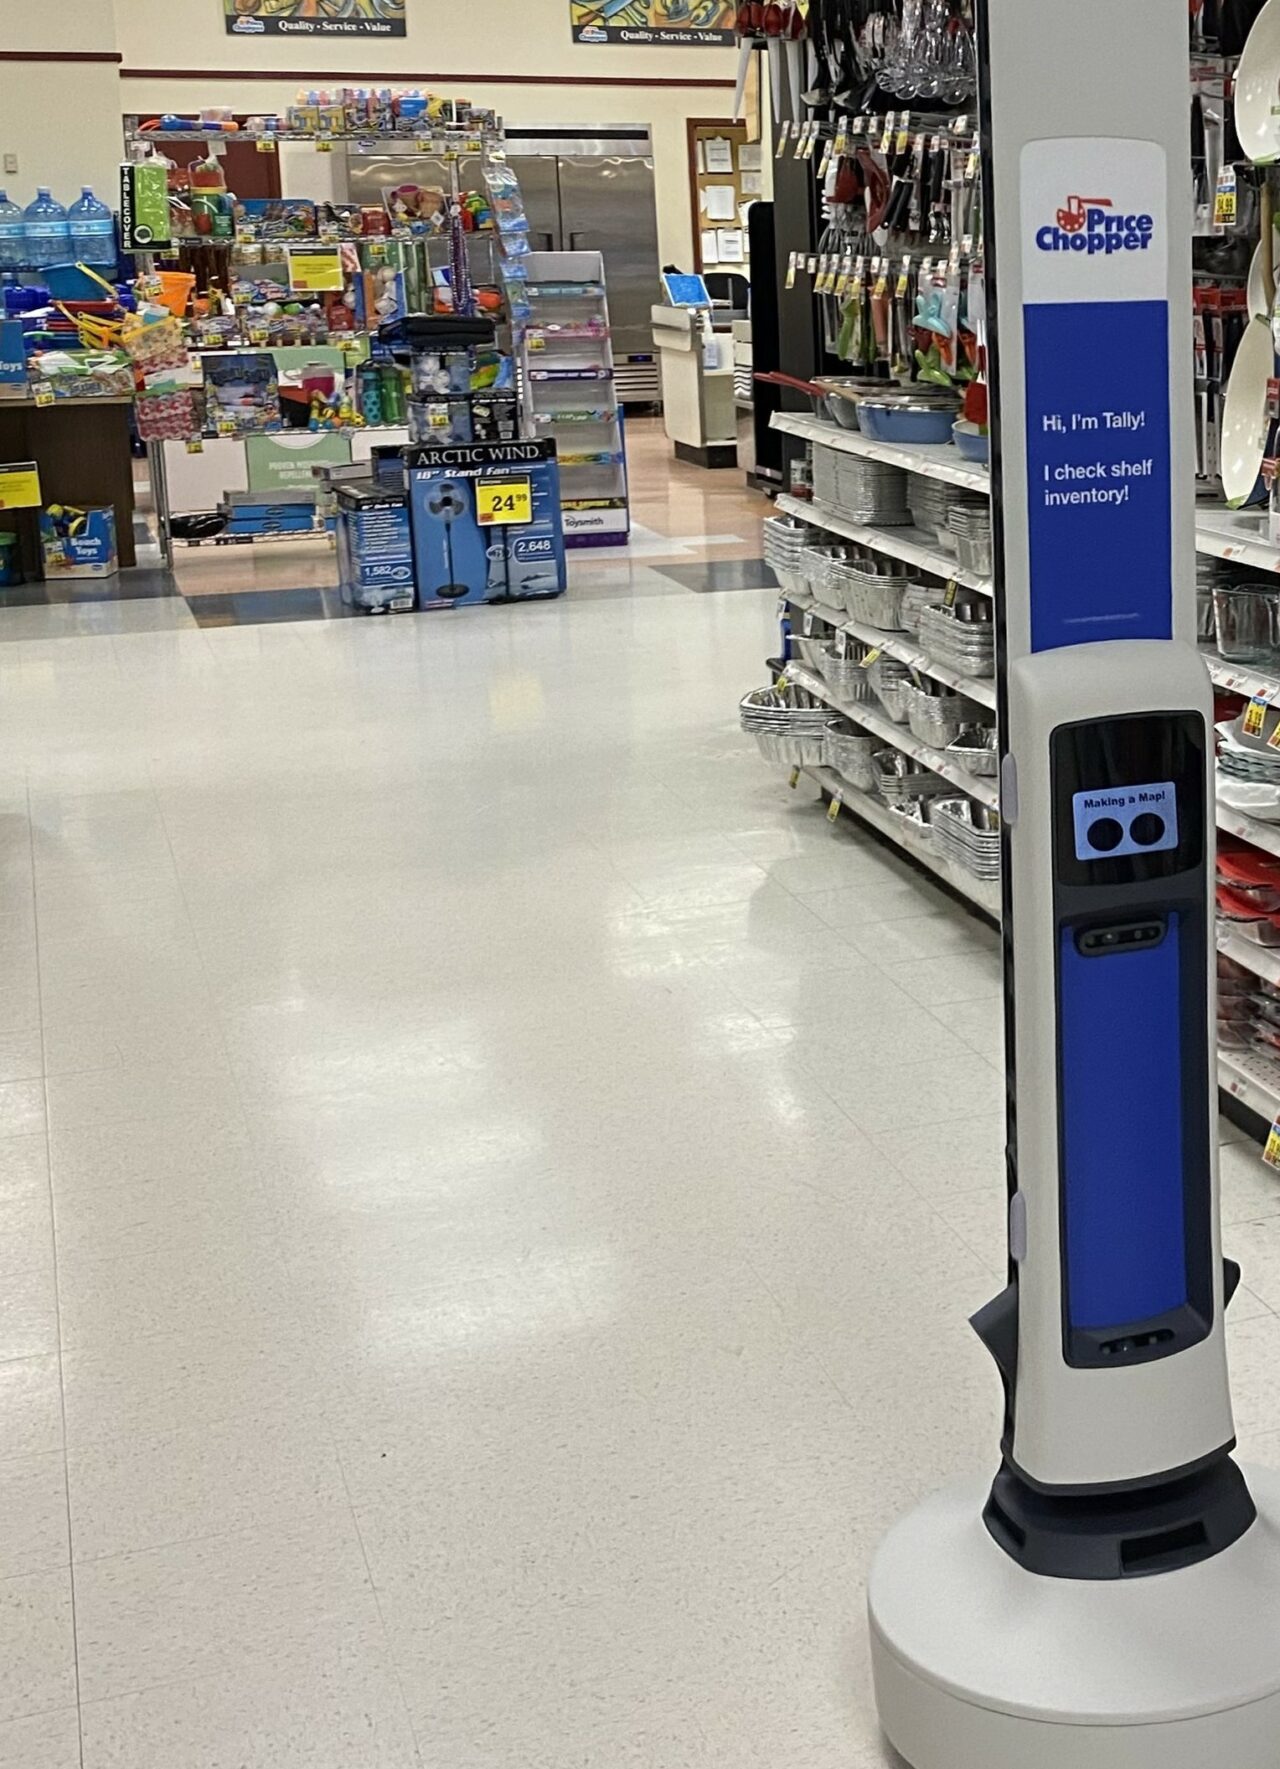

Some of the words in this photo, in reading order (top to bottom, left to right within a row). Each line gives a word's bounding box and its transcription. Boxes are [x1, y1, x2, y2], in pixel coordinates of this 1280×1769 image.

[278, 21, 315, 32] Quality
[322, 22, 357, 31] Service
[364, 22, 391, 32] Value
[620, 30, 653, 41] Quality
[660, 31, 692, 41] Service
[699, 32, 722, 41] Value
[1087, 208, 1153, 233] Price
[1036, 225, 1153, 254] Chopper
[1043, 414, 1067, 433] Hi,
[1071, 414, 1098, 431] I'm
[1102, 411, 1145, 432] Tally!
[417, 449, 484, 466] ARCTIC
[488, 446, 540, 462] WIND
[444, 468, 482, 479] Stand
[486, 466, 512, 476] Fan
[1044, 464, 1049, 480] I
[1054, 461, 1106, 480] check
[1111, 459, 1153, 477] shelf
[492, 495, 515, 512] 24
[516, 493, 528, 502] 99
[1043, 486, 1129, 507] inventory!
[564, 515, 604, 528] Toysmith
[71, 537, 101, 547] Beach
[518, 539, 551, 553] 2,648
[76, 547, 98, 557] Toys
[365, 566, 391, 577] 1,582
[1084, 795, 1125, 809] Making
[1128, 795, 1136, 804] a
[1139, 791, 1166, 804] Map!
